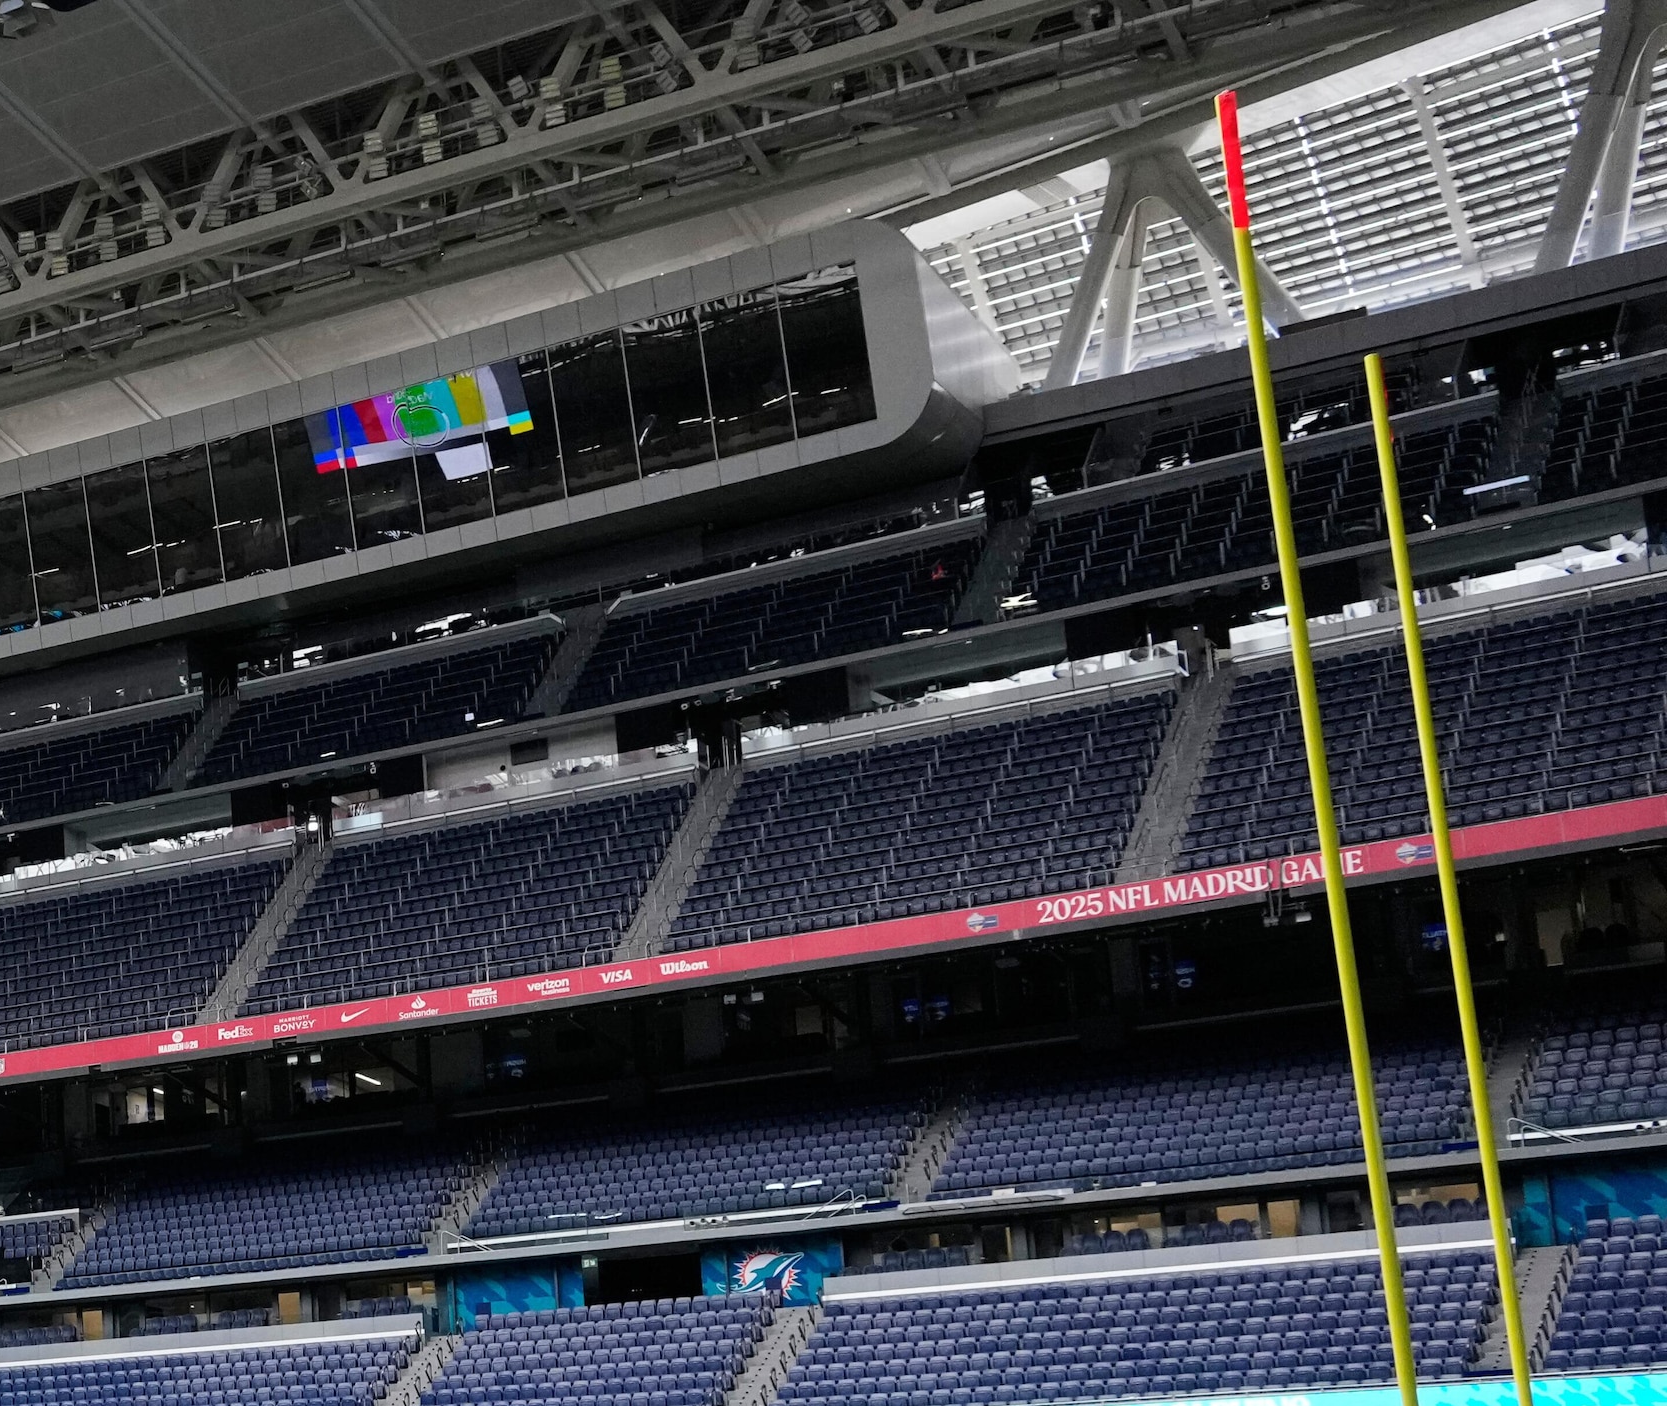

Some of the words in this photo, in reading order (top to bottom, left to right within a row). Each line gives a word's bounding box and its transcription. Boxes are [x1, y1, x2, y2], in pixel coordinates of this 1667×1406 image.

[1037, 894, 1104, 924] 2025
[1109, 884, 1159, 912] NFL
[1164, 865, 1275, 904] MADRID
[660, 959, 709, 976] Wilson
[599, 969, 633, 984] VISA
[527, 978, 570, 992] verizon
[468, 995, 498, 1008] TICKETS
[279, 1014, 311, 1024] MARRIOTT
[398, 1007, 439, 1020] Santander
[218, 1025, 254, 1041] FedEx
[273, 1020, 316, 1034] BONVOY
